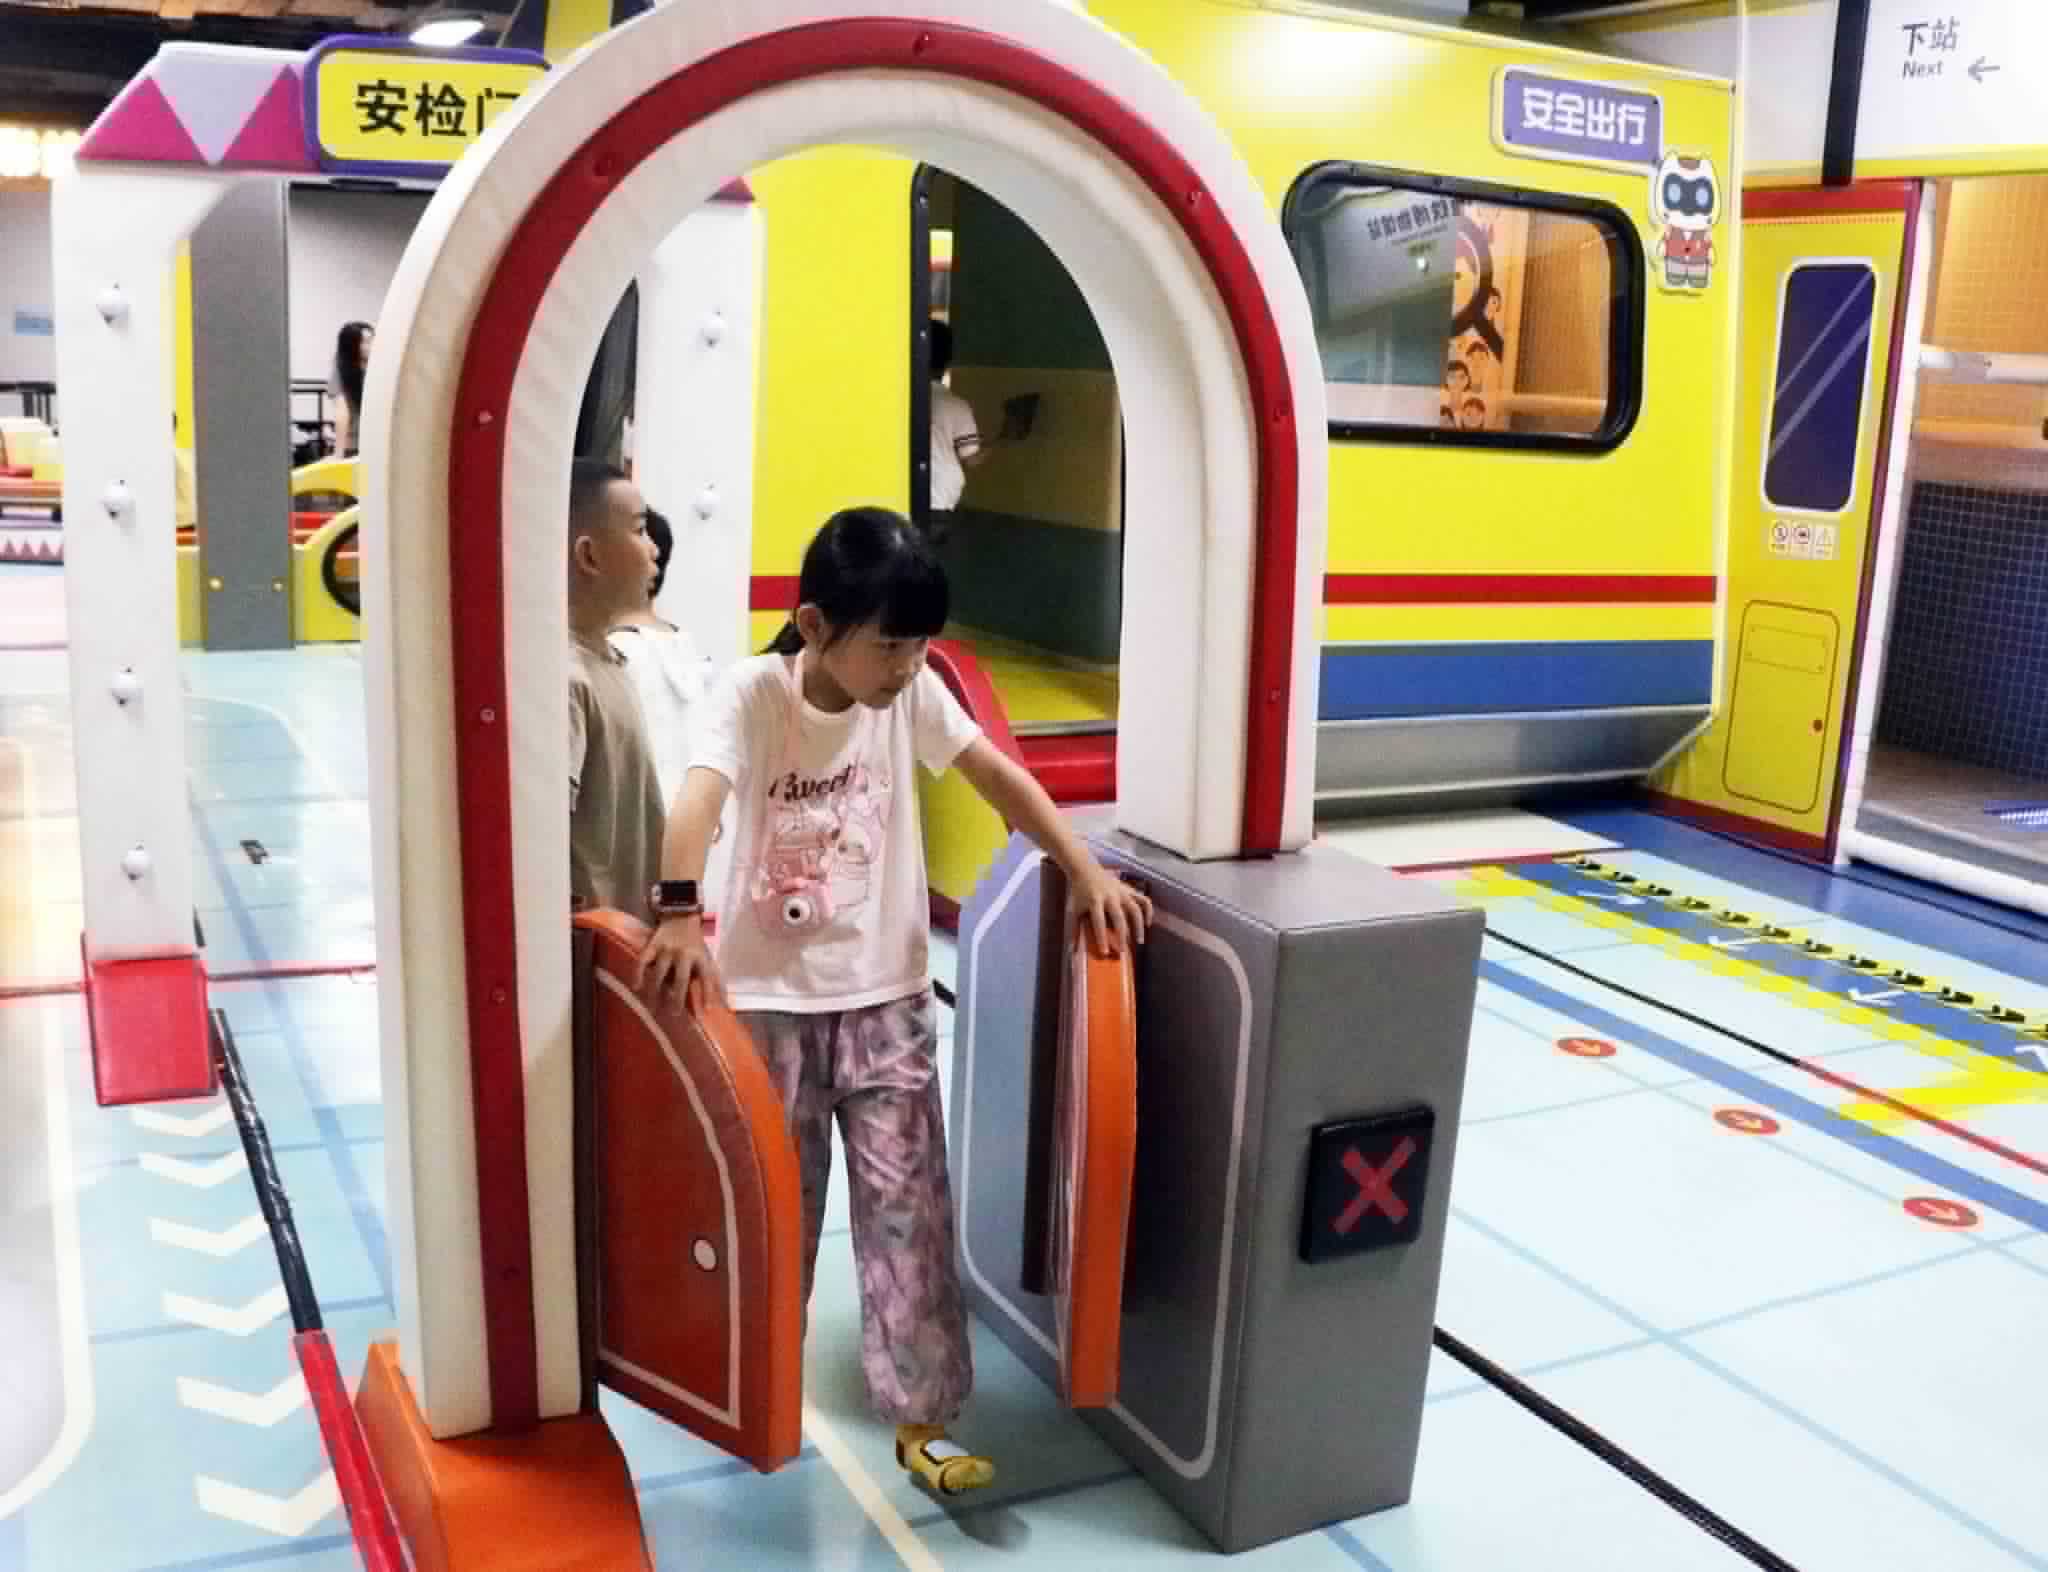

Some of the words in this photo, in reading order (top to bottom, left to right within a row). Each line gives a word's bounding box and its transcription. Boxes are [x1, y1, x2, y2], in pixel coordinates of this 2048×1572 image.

[1902, 16, 1958, 56] 下站
[1903, 60, 1943, 80] Next
[1521, 87, 1647, 145] 安全出行
